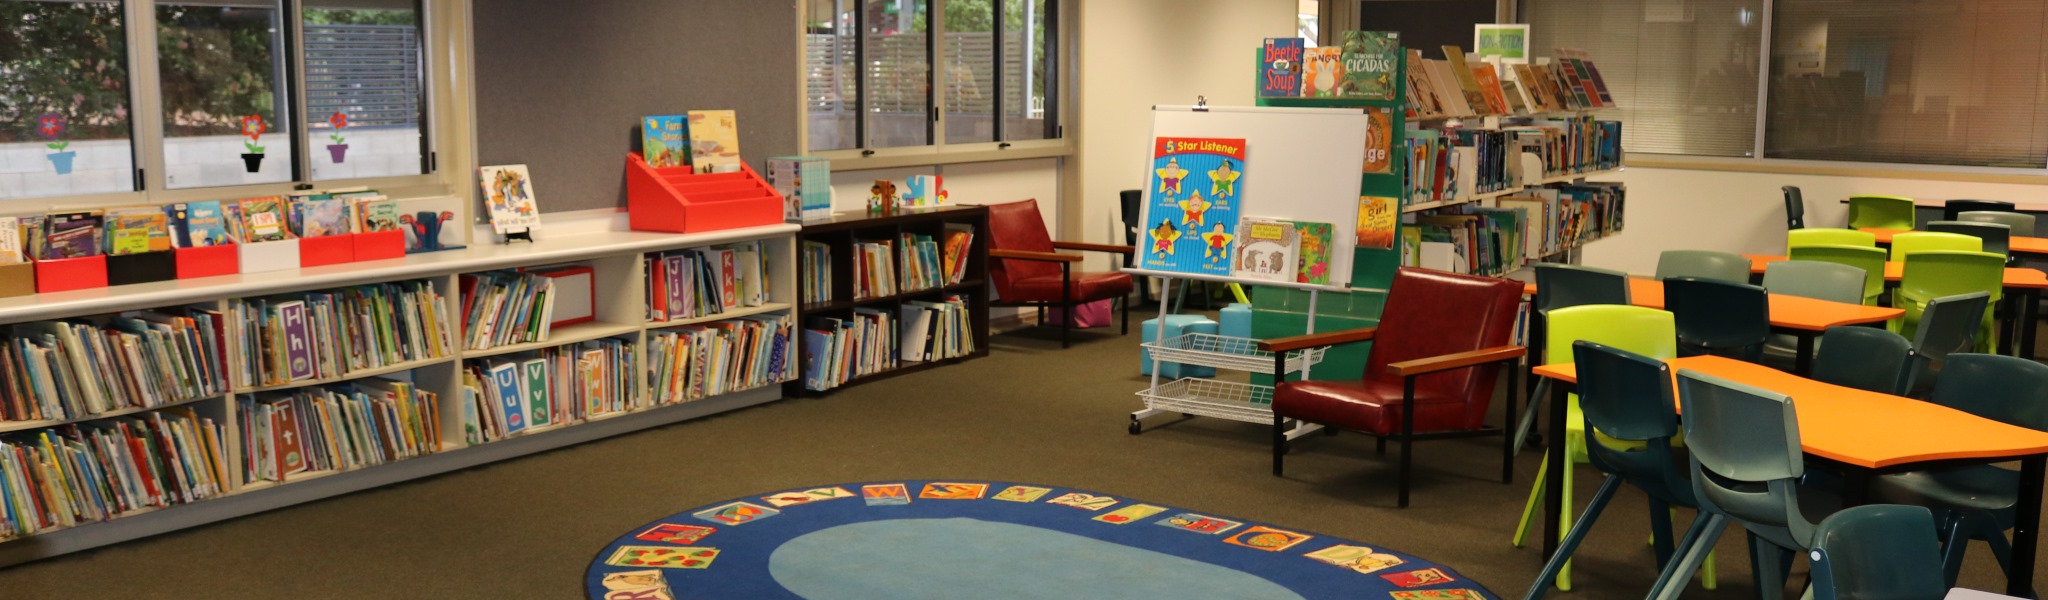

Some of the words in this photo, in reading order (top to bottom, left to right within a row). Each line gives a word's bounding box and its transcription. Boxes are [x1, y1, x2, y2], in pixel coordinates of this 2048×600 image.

[1265, 40, 1300, 62] Beetle
[1346, 59, 1390, 73] CICADAS
[1266, 69, 1294, 97] Soup
[1166, 141, 1174, 153] 5
[1177, 141, 1198, 151] Star
[1200, 141, 1238, 154] Listener
[1368, 203, 1387, 221] girl
[671, 260, 680, 275] J
[724, 254, 732, 267] K
[286, 307, 301, 327] H
[290, 333, 303, 351] h
[500, 370, 513, 387] U
[530, 364, 542, 380] V
[278, 404, 289, 421] T
[283, 430, 293, 445] t
